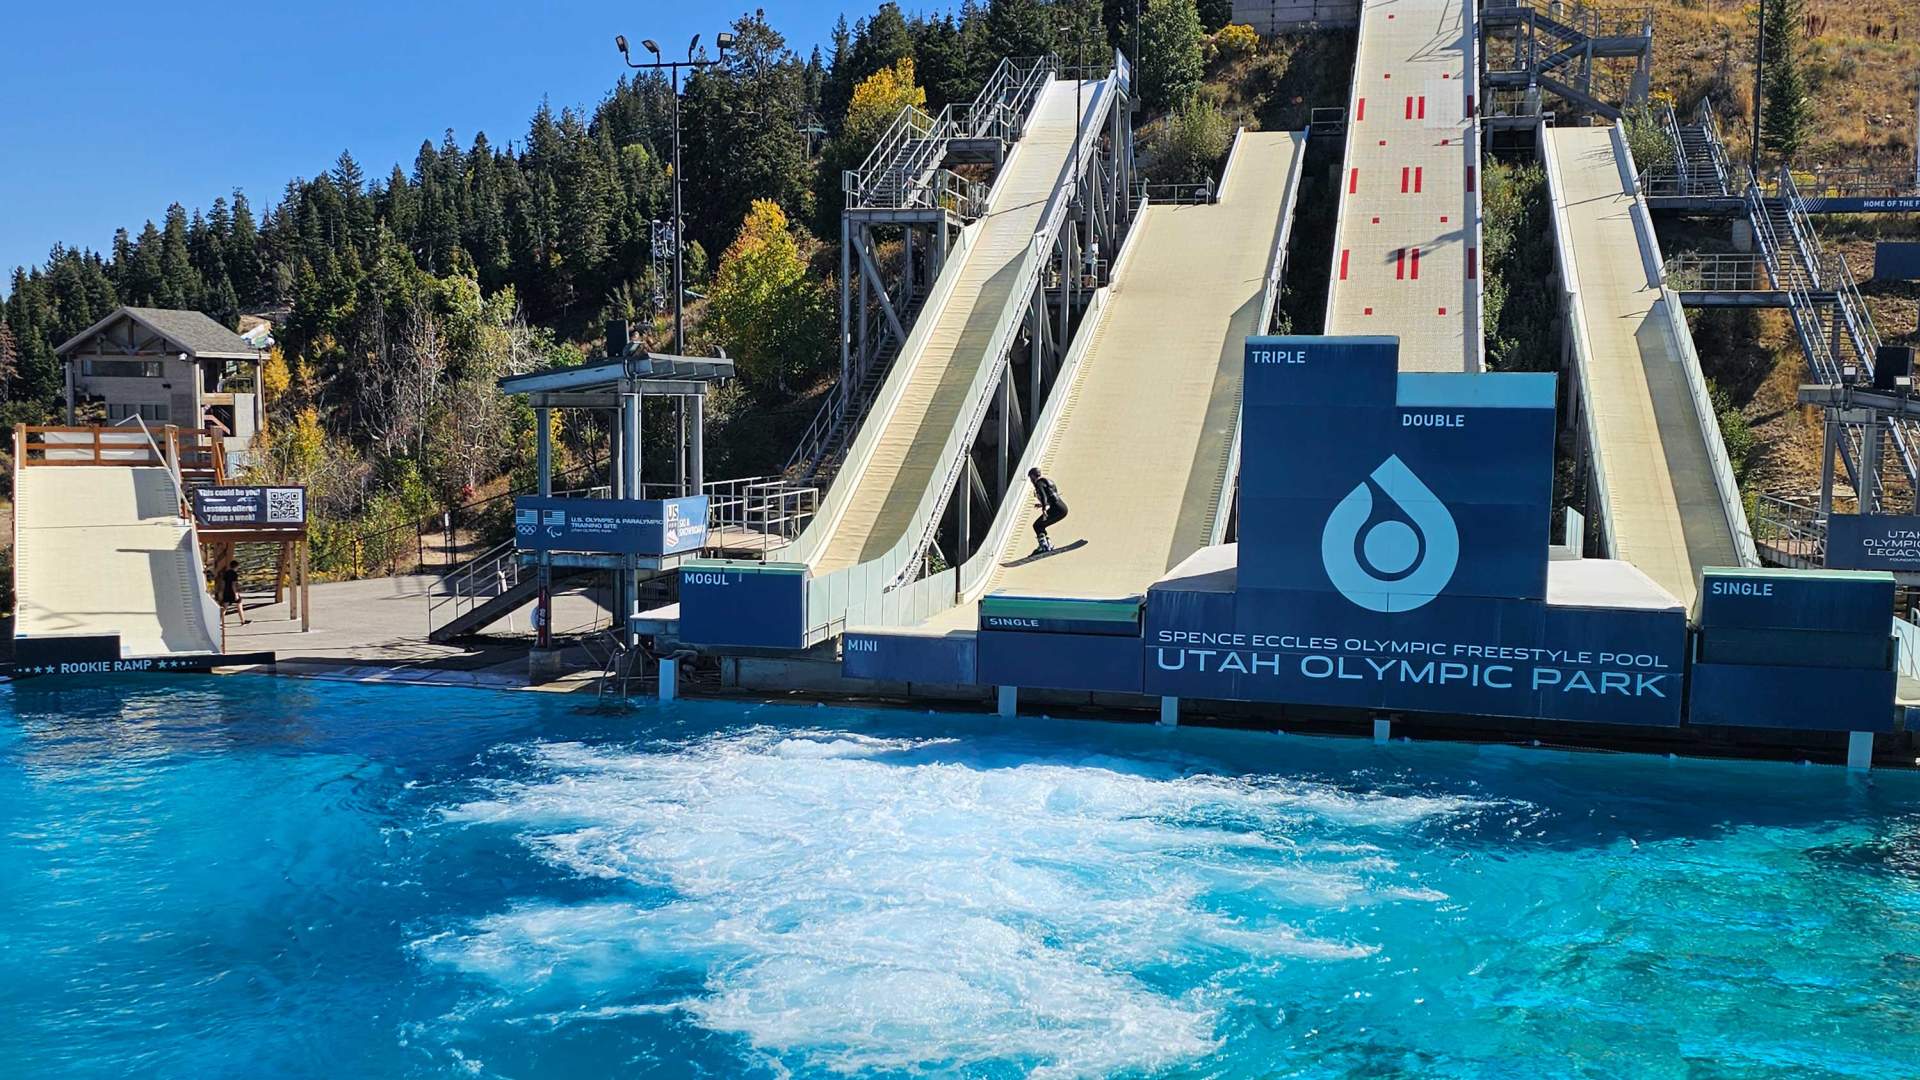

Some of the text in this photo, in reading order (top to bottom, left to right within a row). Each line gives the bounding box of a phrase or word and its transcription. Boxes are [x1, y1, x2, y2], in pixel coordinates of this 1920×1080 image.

[1252, 351, 1306, 364] TRIPLE
[1402, 414, 1465, 427] DOUBLE
[197, 488, 214, 496] This
[214, 488, 234, 496] could
[235, 488, 244, 496] be
[668, 506, 678, 520] US
[684, 573, 729, 585] MOGUL
[1712, 582, 1774, 596] SINGLE
[989, 618, 1039, 627] SINGLE
[848, 640, 878, 652] MINI
[1158, 630, 1669, 668] SPENCE ECCLES OLYMPIC FREESTYLE POOL
[60, 660, 152, 674] ROOKIE RAMP
[1158, 648, 1667, 698] UTAH OLYMPIC PARK
